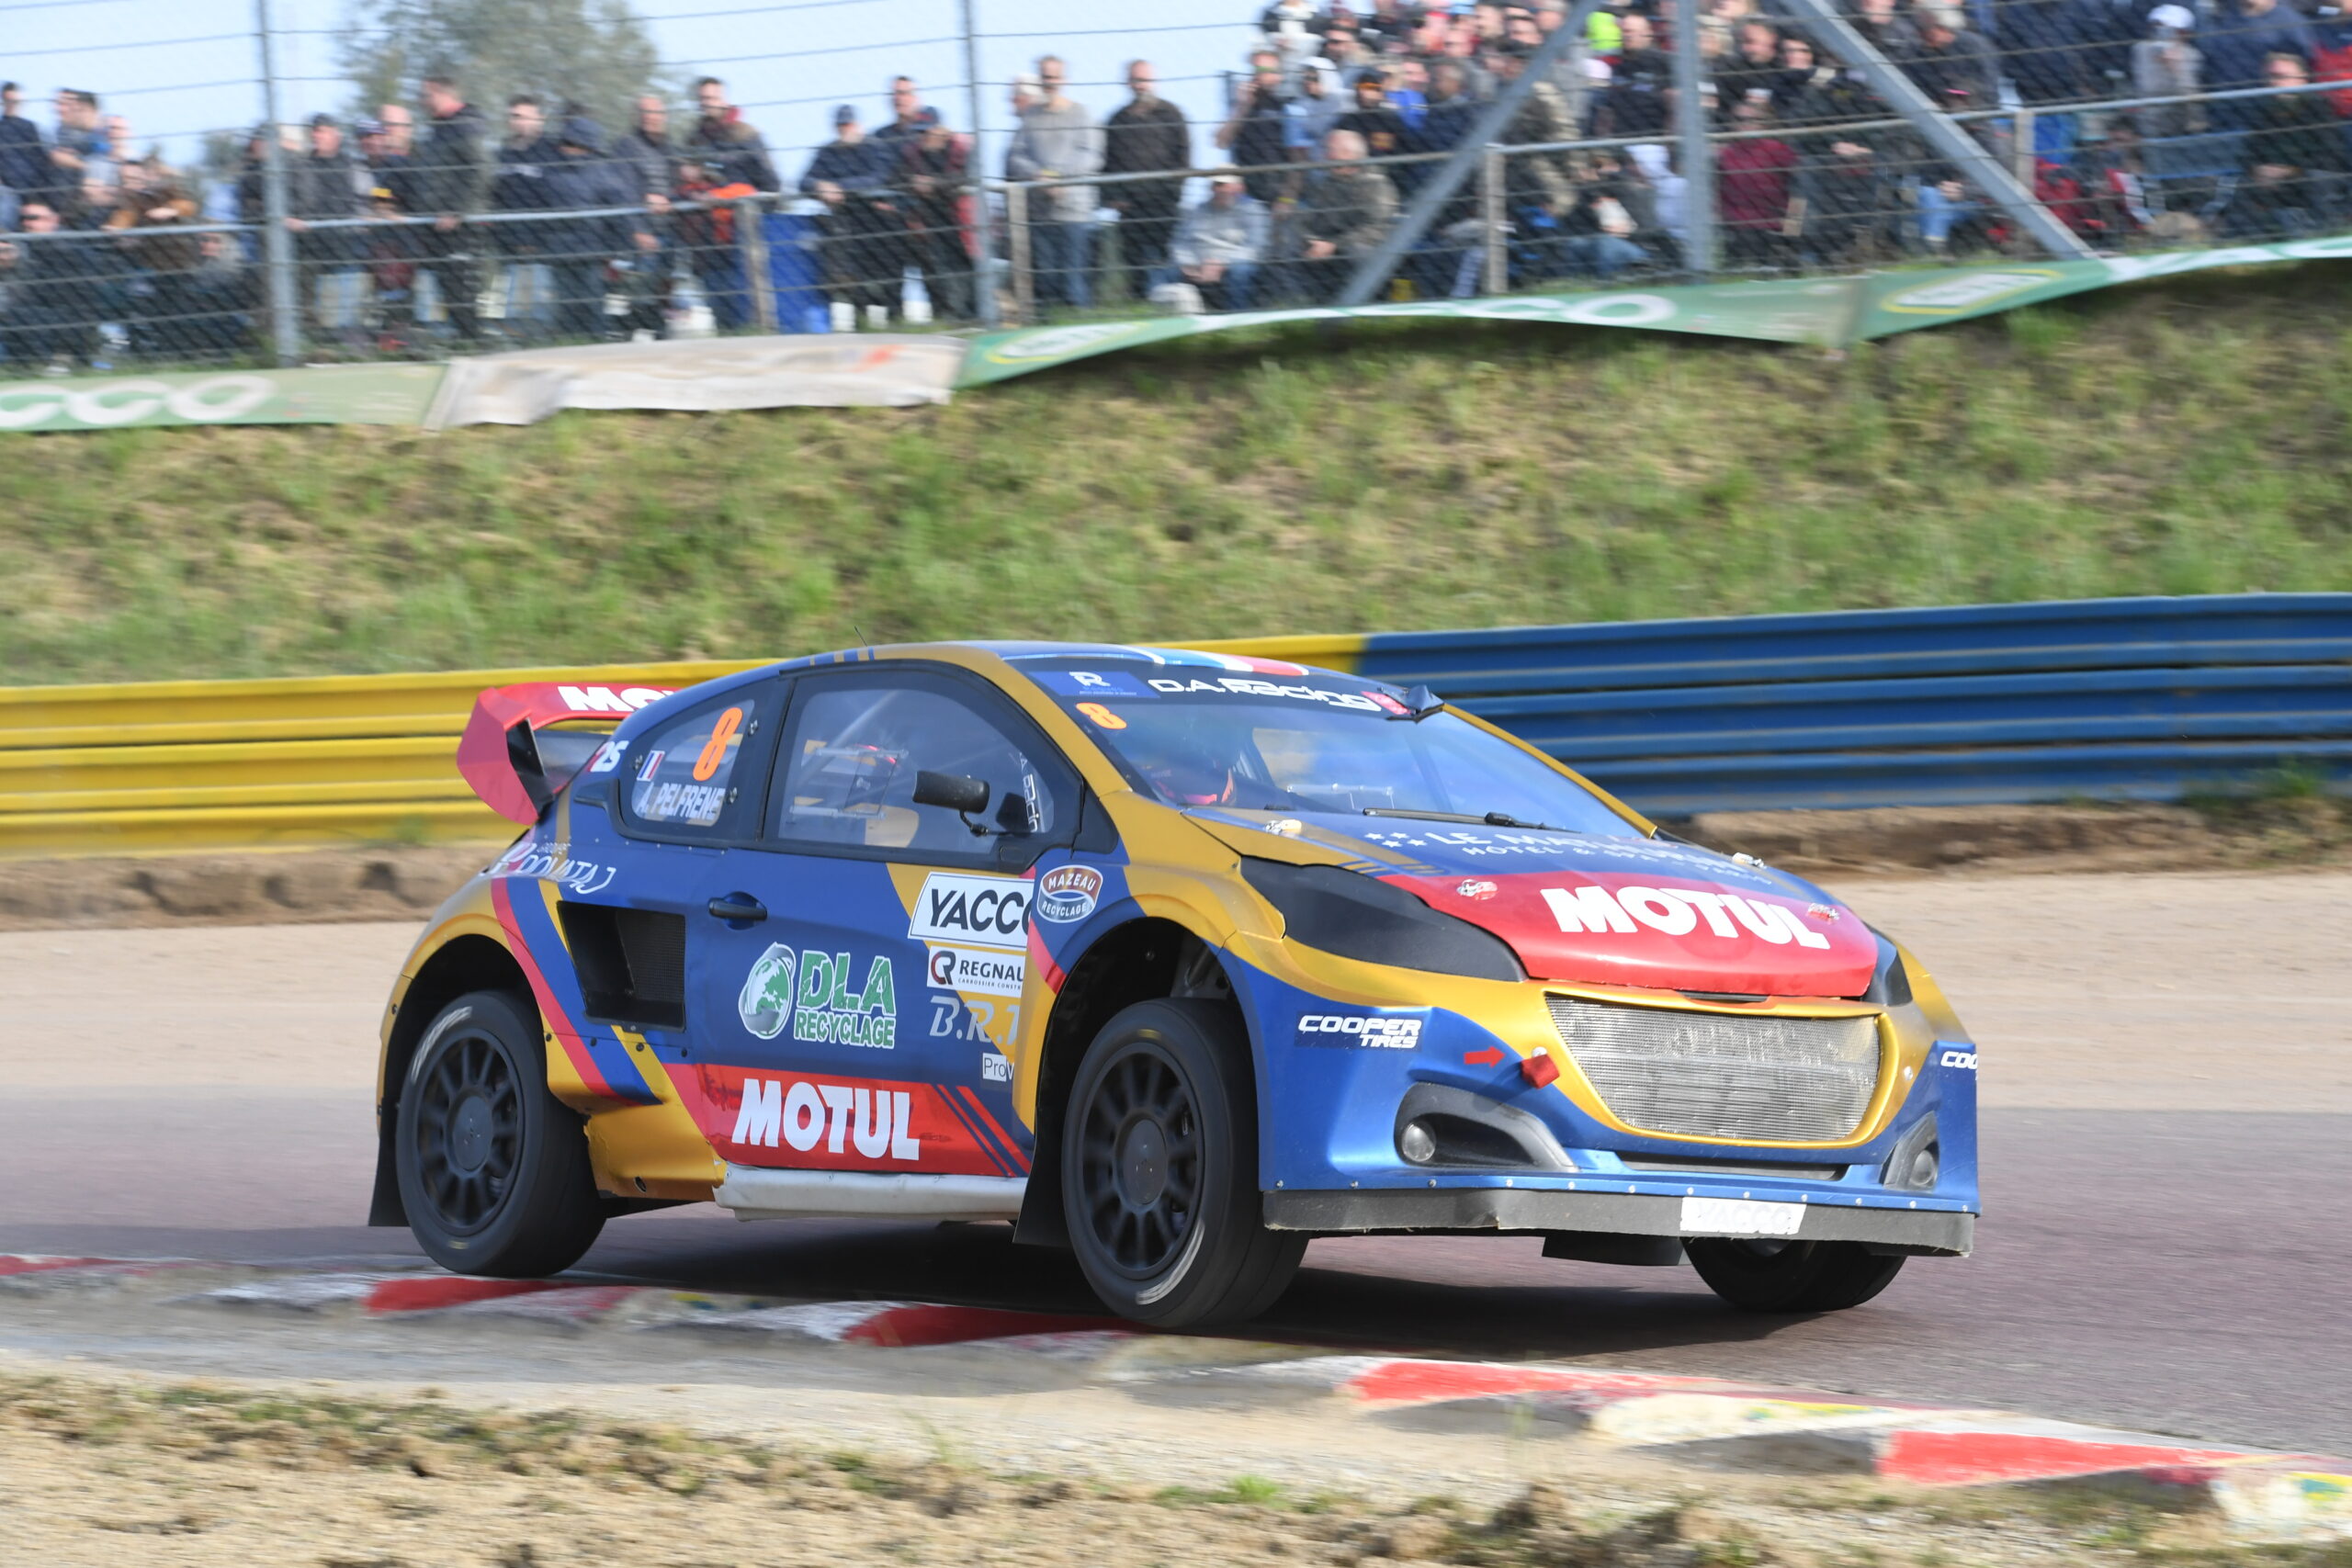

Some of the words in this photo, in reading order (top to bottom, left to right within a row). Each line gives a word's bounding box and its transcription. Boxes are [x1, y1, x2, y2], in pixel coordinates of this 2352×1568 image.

[558, 686, 674, 712] MO
[1076, 702, 1127, 729] 8
[693, 707, 743, 782] 8
[1048, 874, 1097, 892] MAZEAU
[1041, 900, 1088, 917] RECYCLAGE
[1540, 886, 1831, 950] MOTUL
[797, 950, 897, 1015] DLA
[957, 977, 994, 987] CARROSSIER
[794, 1010, 896, 1049] RECYCLAGE
[1298, 1015, 1422, 1036] COOPER
[1359, 1033, 1419, 1049] TIRES
[732, 1078, 920, 1160] MOTUL
